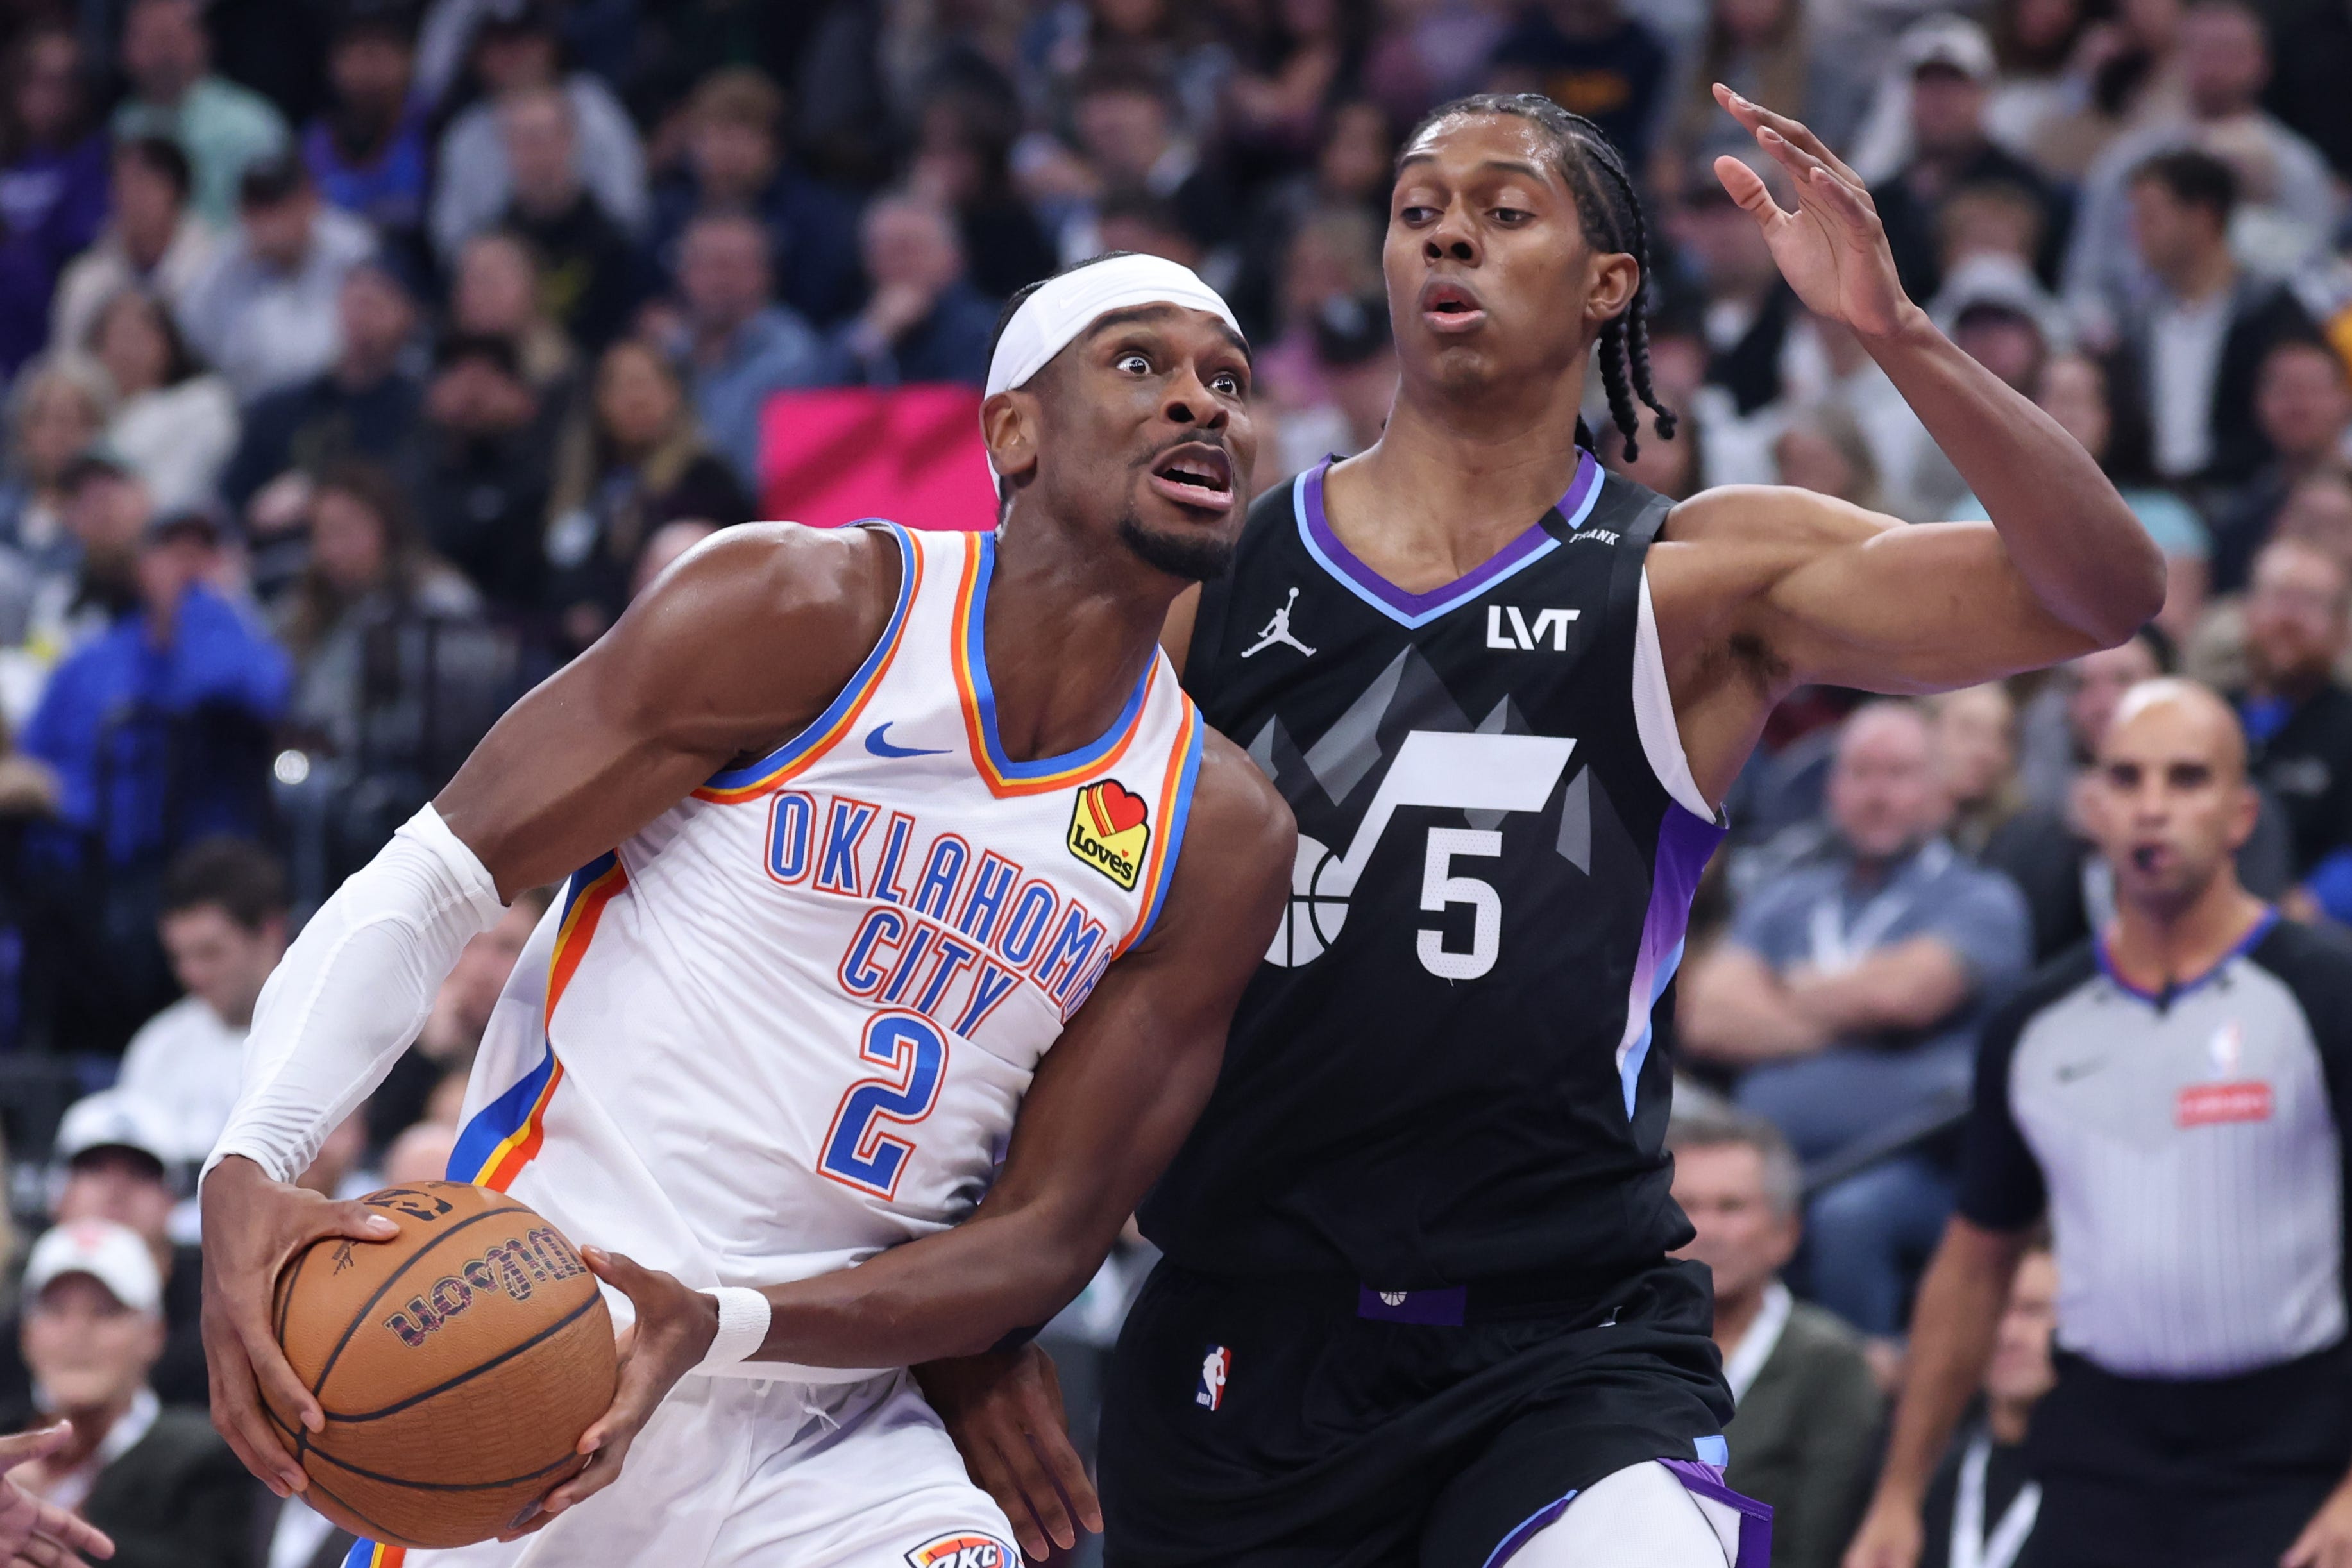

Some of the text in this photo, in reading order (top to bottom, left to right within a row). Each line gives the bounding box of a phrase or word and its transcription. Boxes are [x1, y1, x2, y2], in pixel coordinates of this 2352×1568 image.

[1569, 528, 1620, 546] FRANK
[1487, 605, 1581, 652] LVT
[1416, 827, 1503, 980] 5
[837, 905, 1025, 1040] CITY
[816, 1007, 949, 1202] 2
[382, 1226, 588, 1349] Wilson
[1196, 1392, 1211, 1406] NBA
[927, 1544, 997, 1568] OKC
